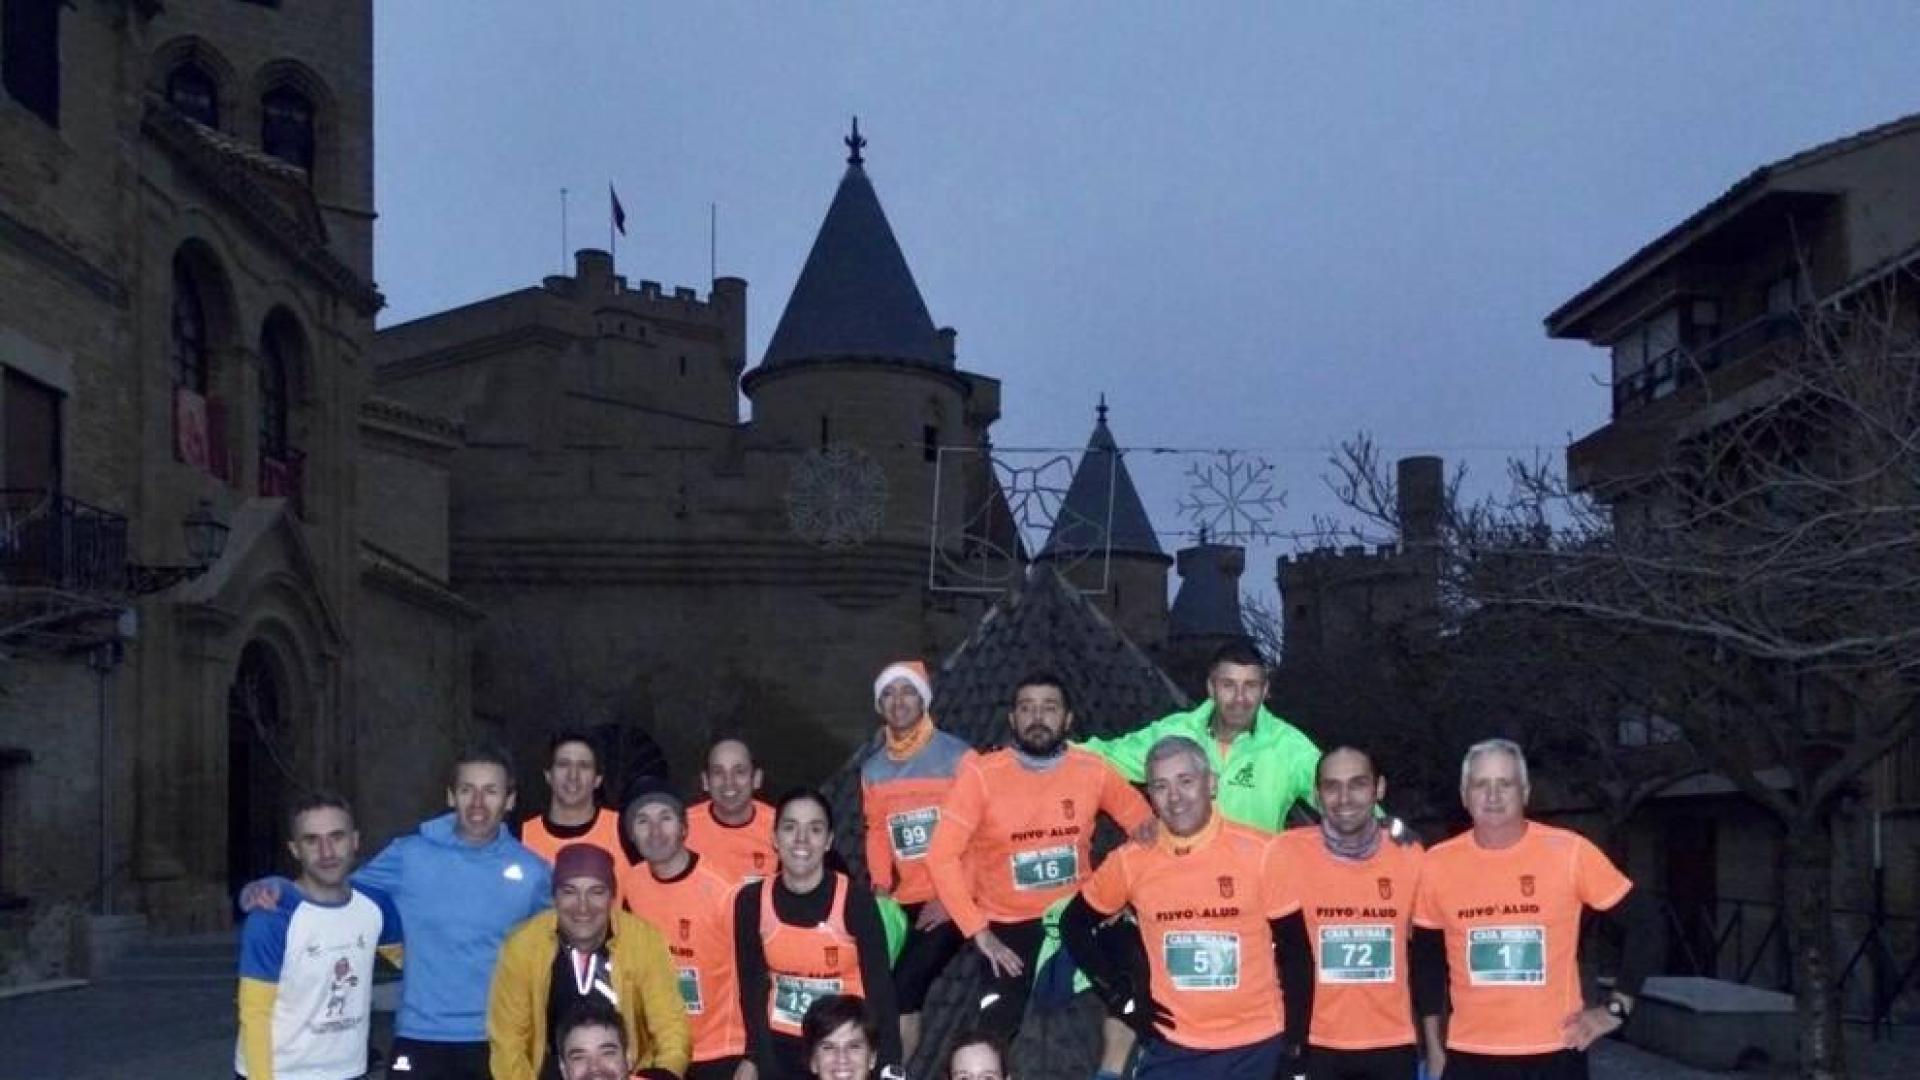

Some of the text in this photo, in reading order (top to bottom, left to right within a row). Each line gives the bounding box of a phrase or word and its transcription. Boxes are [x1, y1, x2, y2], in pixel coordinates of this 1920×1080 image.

[903, 826, 926, 846] 99
[1032, 860, 1059, 880] 16
[1193, 949, 1208, 973] 5
[1341, 943, 1372, 967] 72
[1497, 945, 1510, 968] 1
[787, 992, 812, 1013] 13
